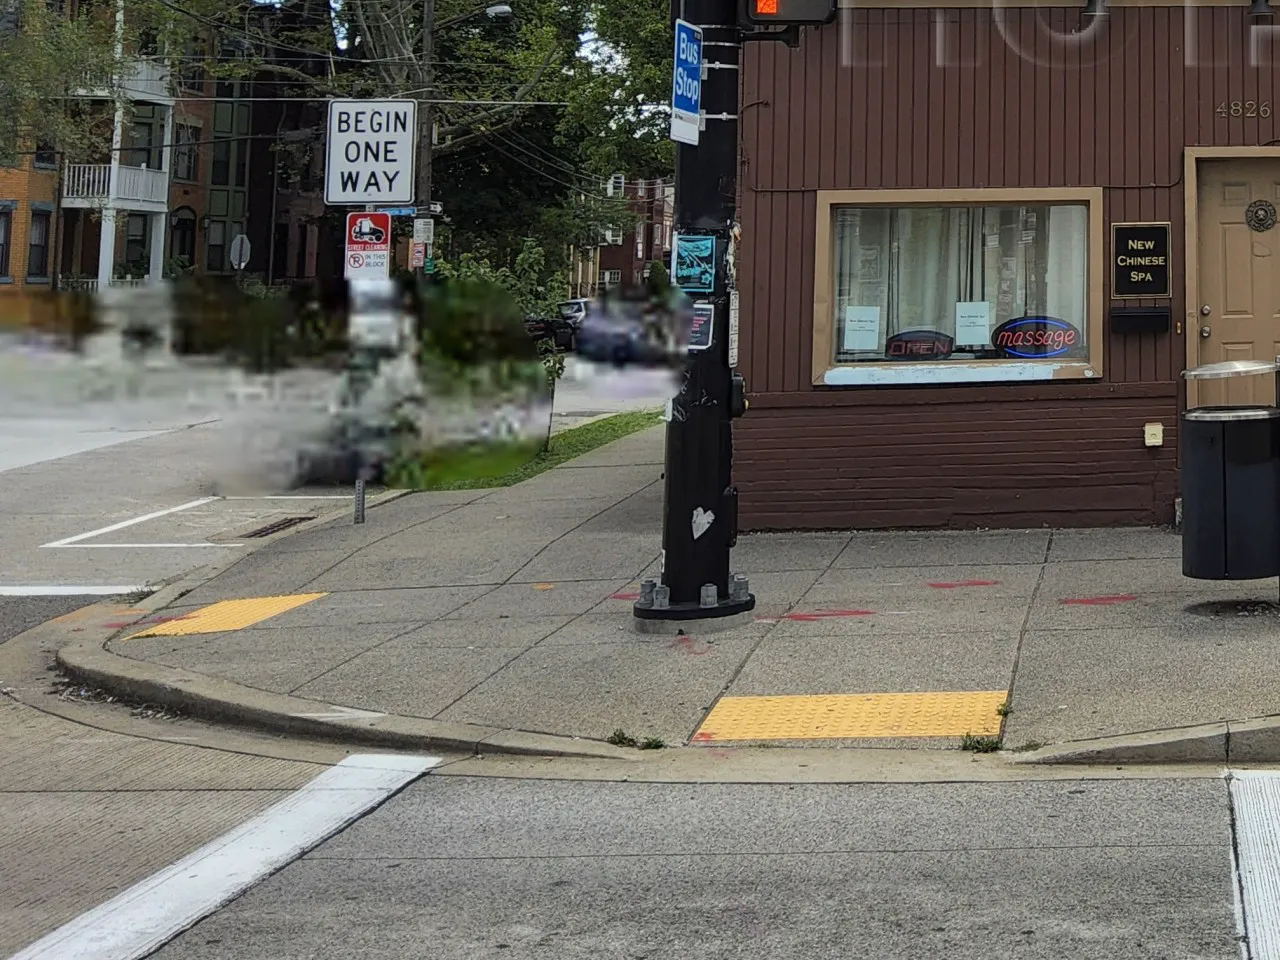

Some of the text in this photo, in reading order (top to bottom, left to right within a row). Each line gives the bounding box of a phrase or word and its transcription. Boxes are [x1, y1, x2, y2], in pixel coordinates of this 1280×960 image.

[679, 32, 699, 65] Bus
[676, 68, 699, 105] Stop
[1216, 100, 1271, 118] 4826
[338, 111, 407, 133] BEGIN
[344, 140, 398, 163] ONE
[340, 170, 400, 194] WAY
[889, 340, 949, 356] OPEN
[996, 329, 1076, 350] massage
